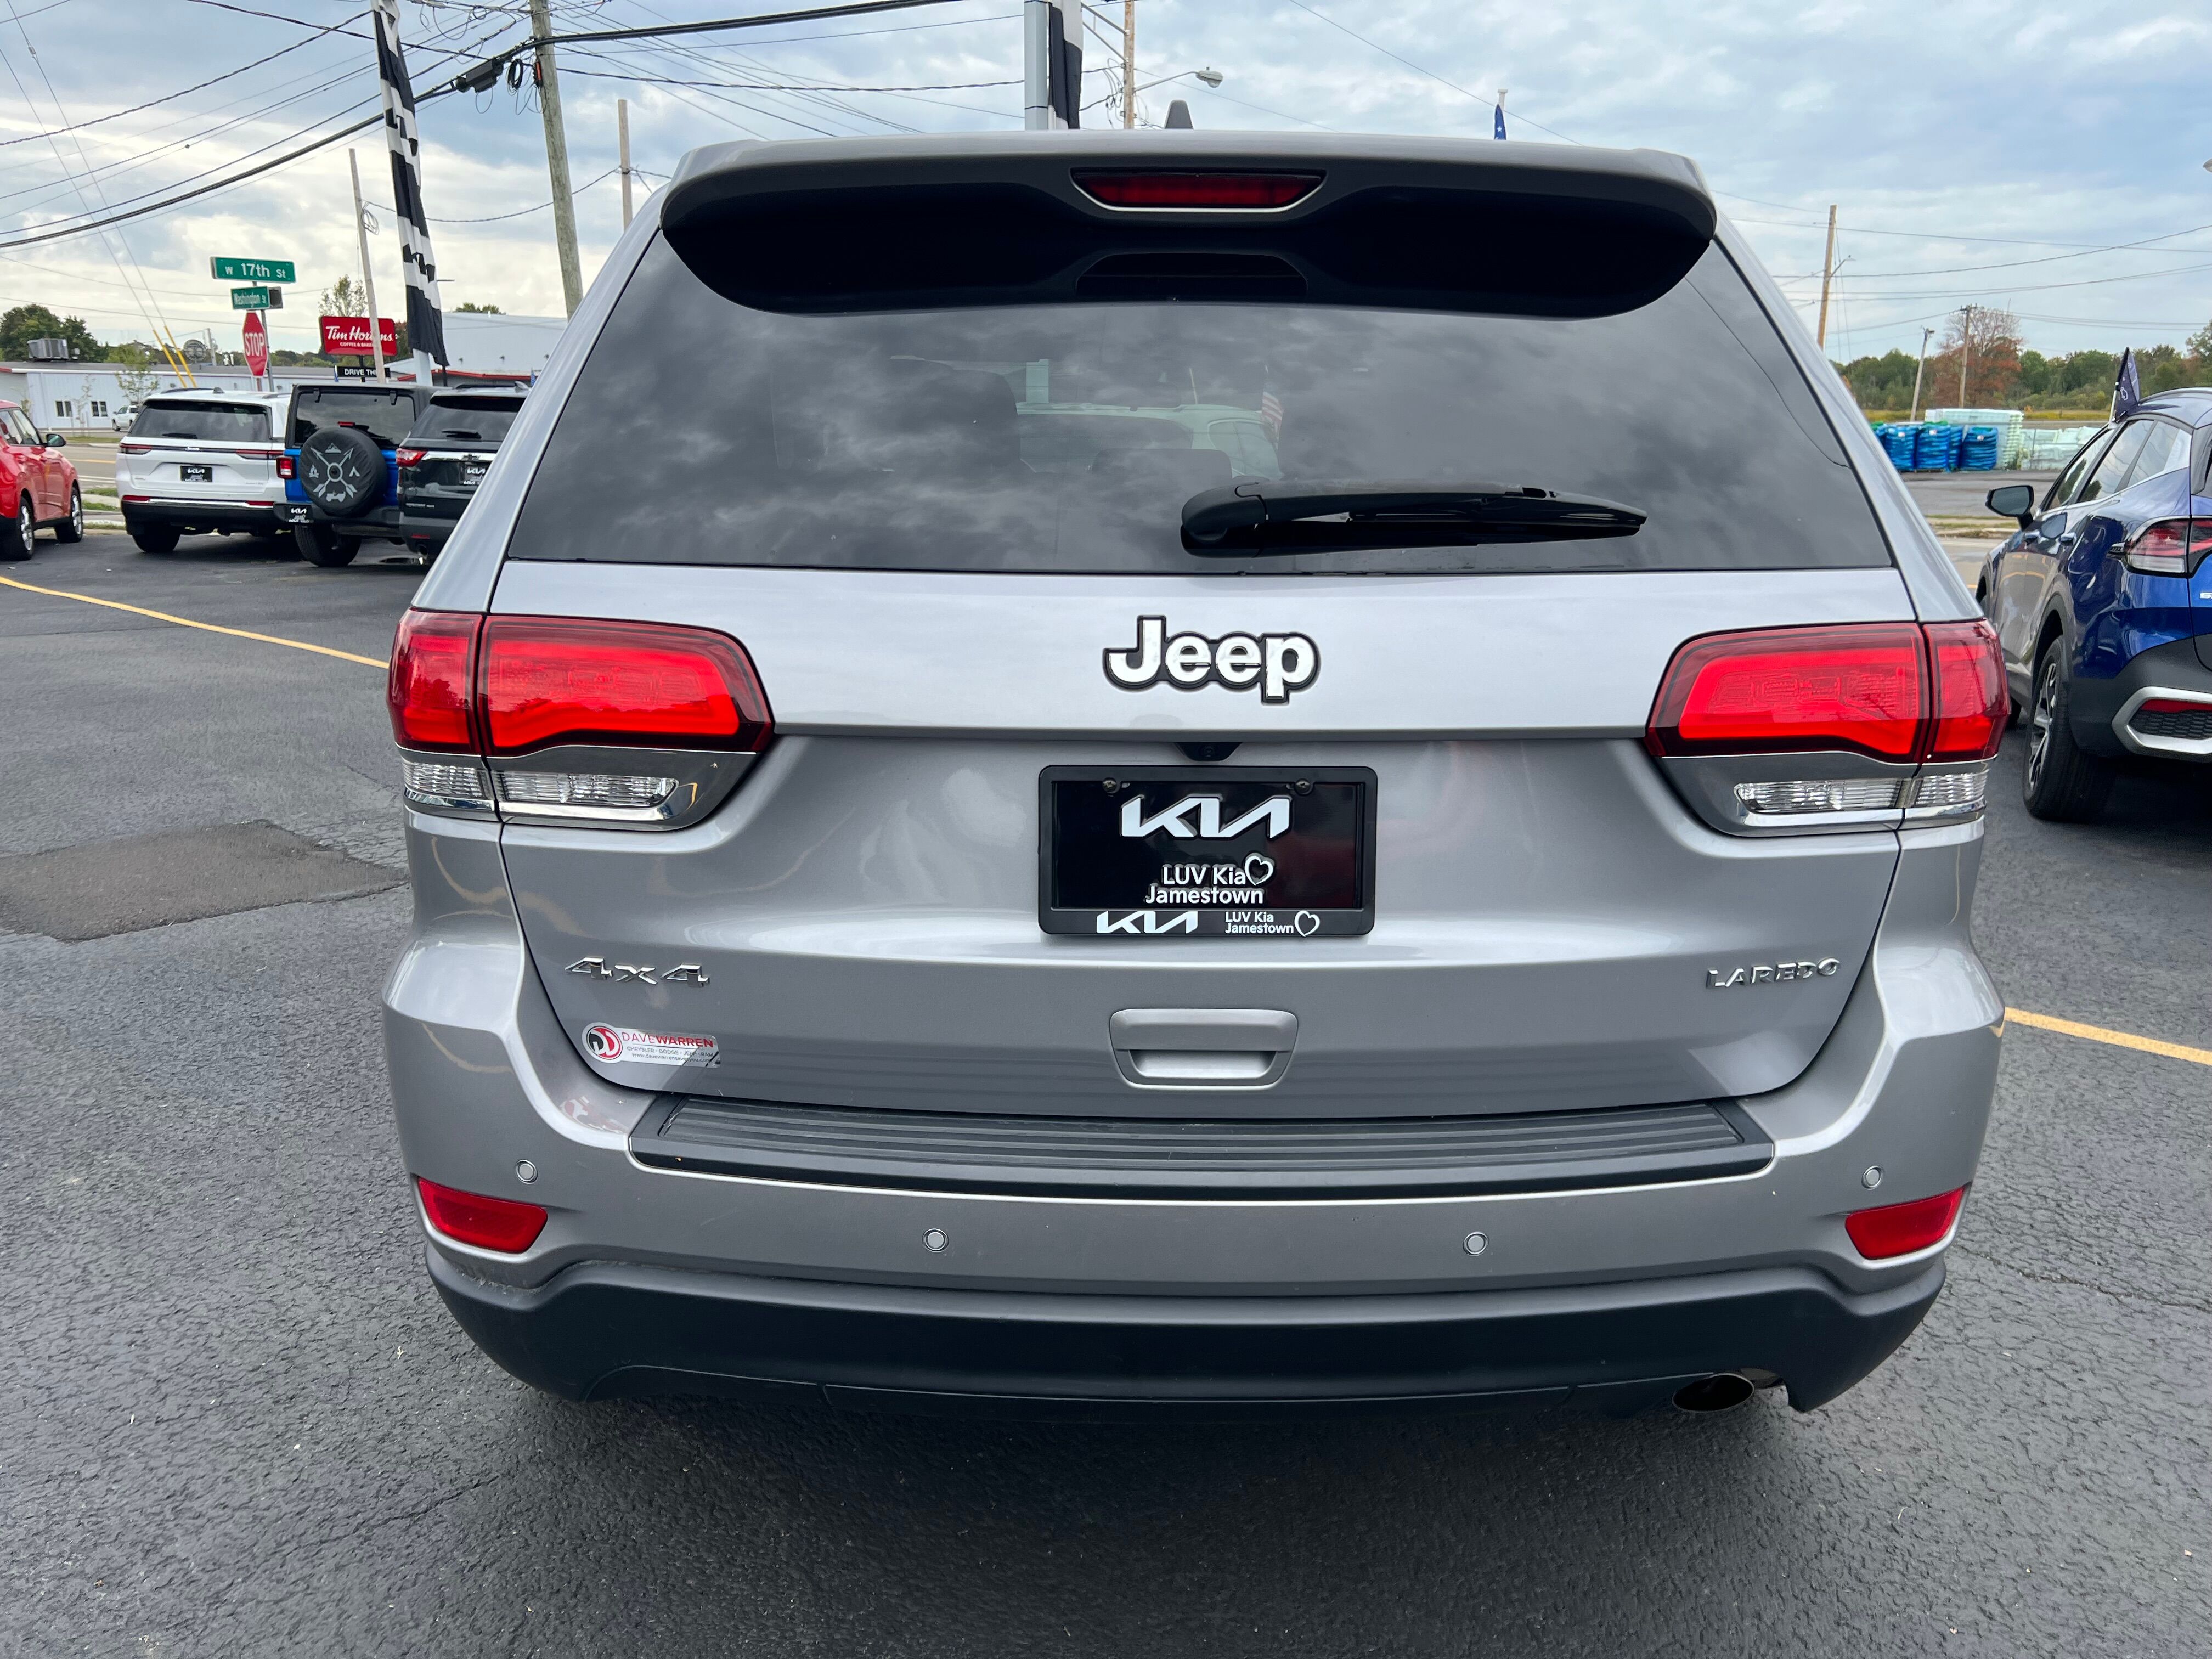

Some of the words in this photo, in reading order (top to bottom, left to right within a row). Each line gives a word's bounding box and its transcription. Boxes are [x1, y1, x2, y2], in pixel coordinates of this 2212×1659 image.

[241, 263, 270, 277] 17th
[276, 268, 286, 278] St
[325, 325, 347, 340] Tim
[245, 332, 264, 356] STOP
[1104, 617, 1318, 702] Jeep
[1121, 795, 1291, 838] KIA
[1163, 866, 1206, 884] LUV
[1213, 866, 1246, 885] Kia
[1146, 885, 1263, 904] Jamestown
[1097, 911, 1198, 934] KIA
[1225, 911, 1252, 923] LUV
[1254, 911, 1274, 923] Kia
[1225, 923, 1294, 934] Jamestown
[1706, 957, 1841, 988] LAREDO
